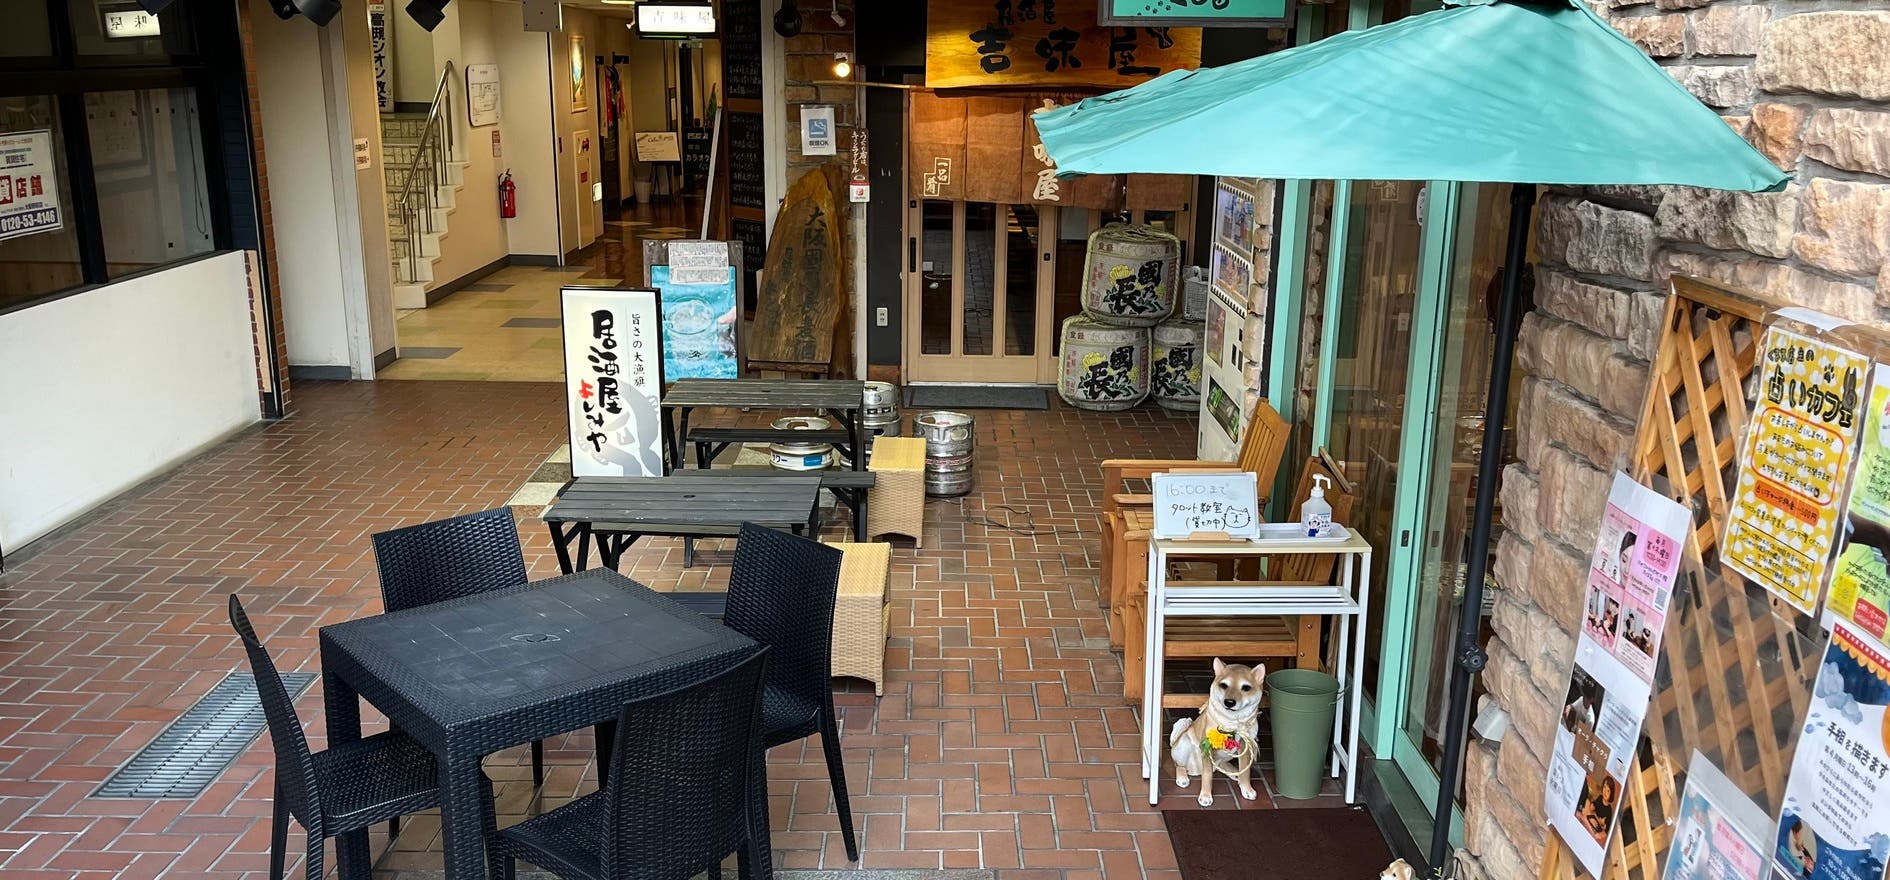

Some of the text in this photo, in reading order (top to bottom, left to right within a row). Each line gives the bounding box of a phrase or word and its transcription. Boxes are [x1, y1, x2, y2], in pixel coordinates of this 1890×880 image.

[968, 22, 1162, 76] 吉味屋
[1, 211, 57, 233] 0120-53-4146
[587, 309, 622, 415] 居酒屋
[1767, 363, 1854, 429] 占いカフェ
